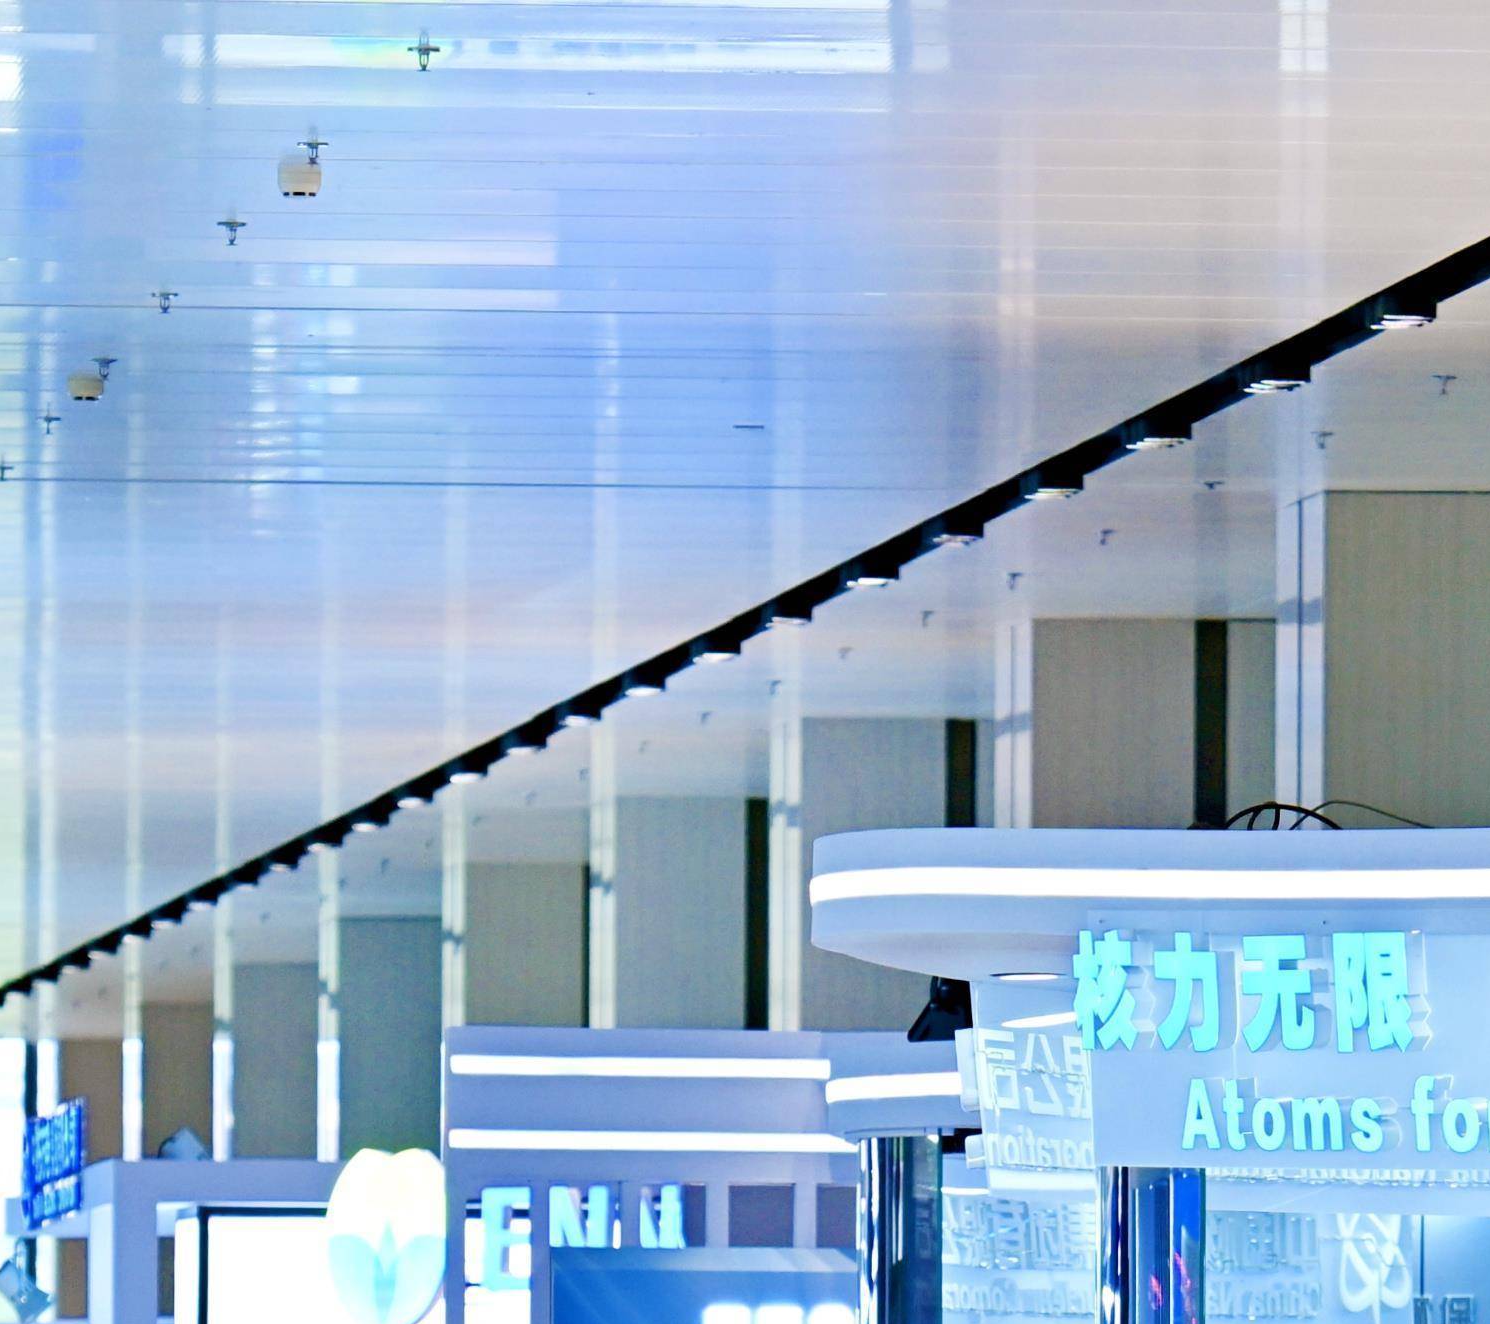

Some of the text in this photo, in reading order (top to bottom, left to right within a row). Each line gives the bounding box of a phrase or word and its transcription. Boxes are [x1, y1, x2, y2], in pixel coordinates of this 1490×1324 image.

[1071, 928, 1413, 1054] 核力无限
[1181, 1074, 1384, 1153] Atoms
